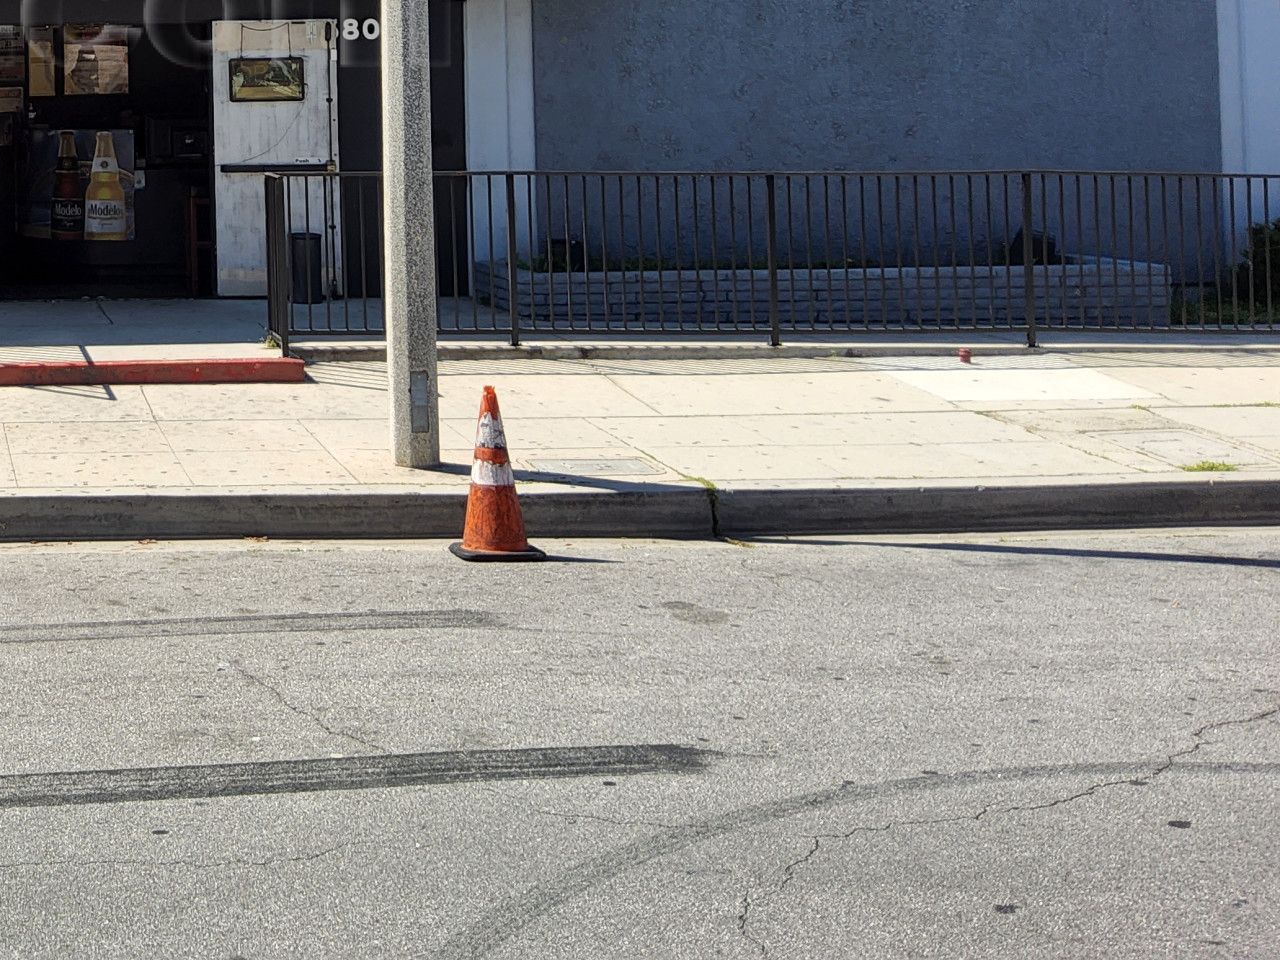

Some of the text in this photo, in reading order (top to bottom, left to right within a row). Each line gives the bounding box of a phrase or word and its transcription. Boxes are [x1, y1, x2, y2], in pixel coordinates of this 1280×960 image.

[336, 17, 380, 41] 80
[55, 203, 82, 215] Modelo
[88, 203, 121, 216] Modelo
